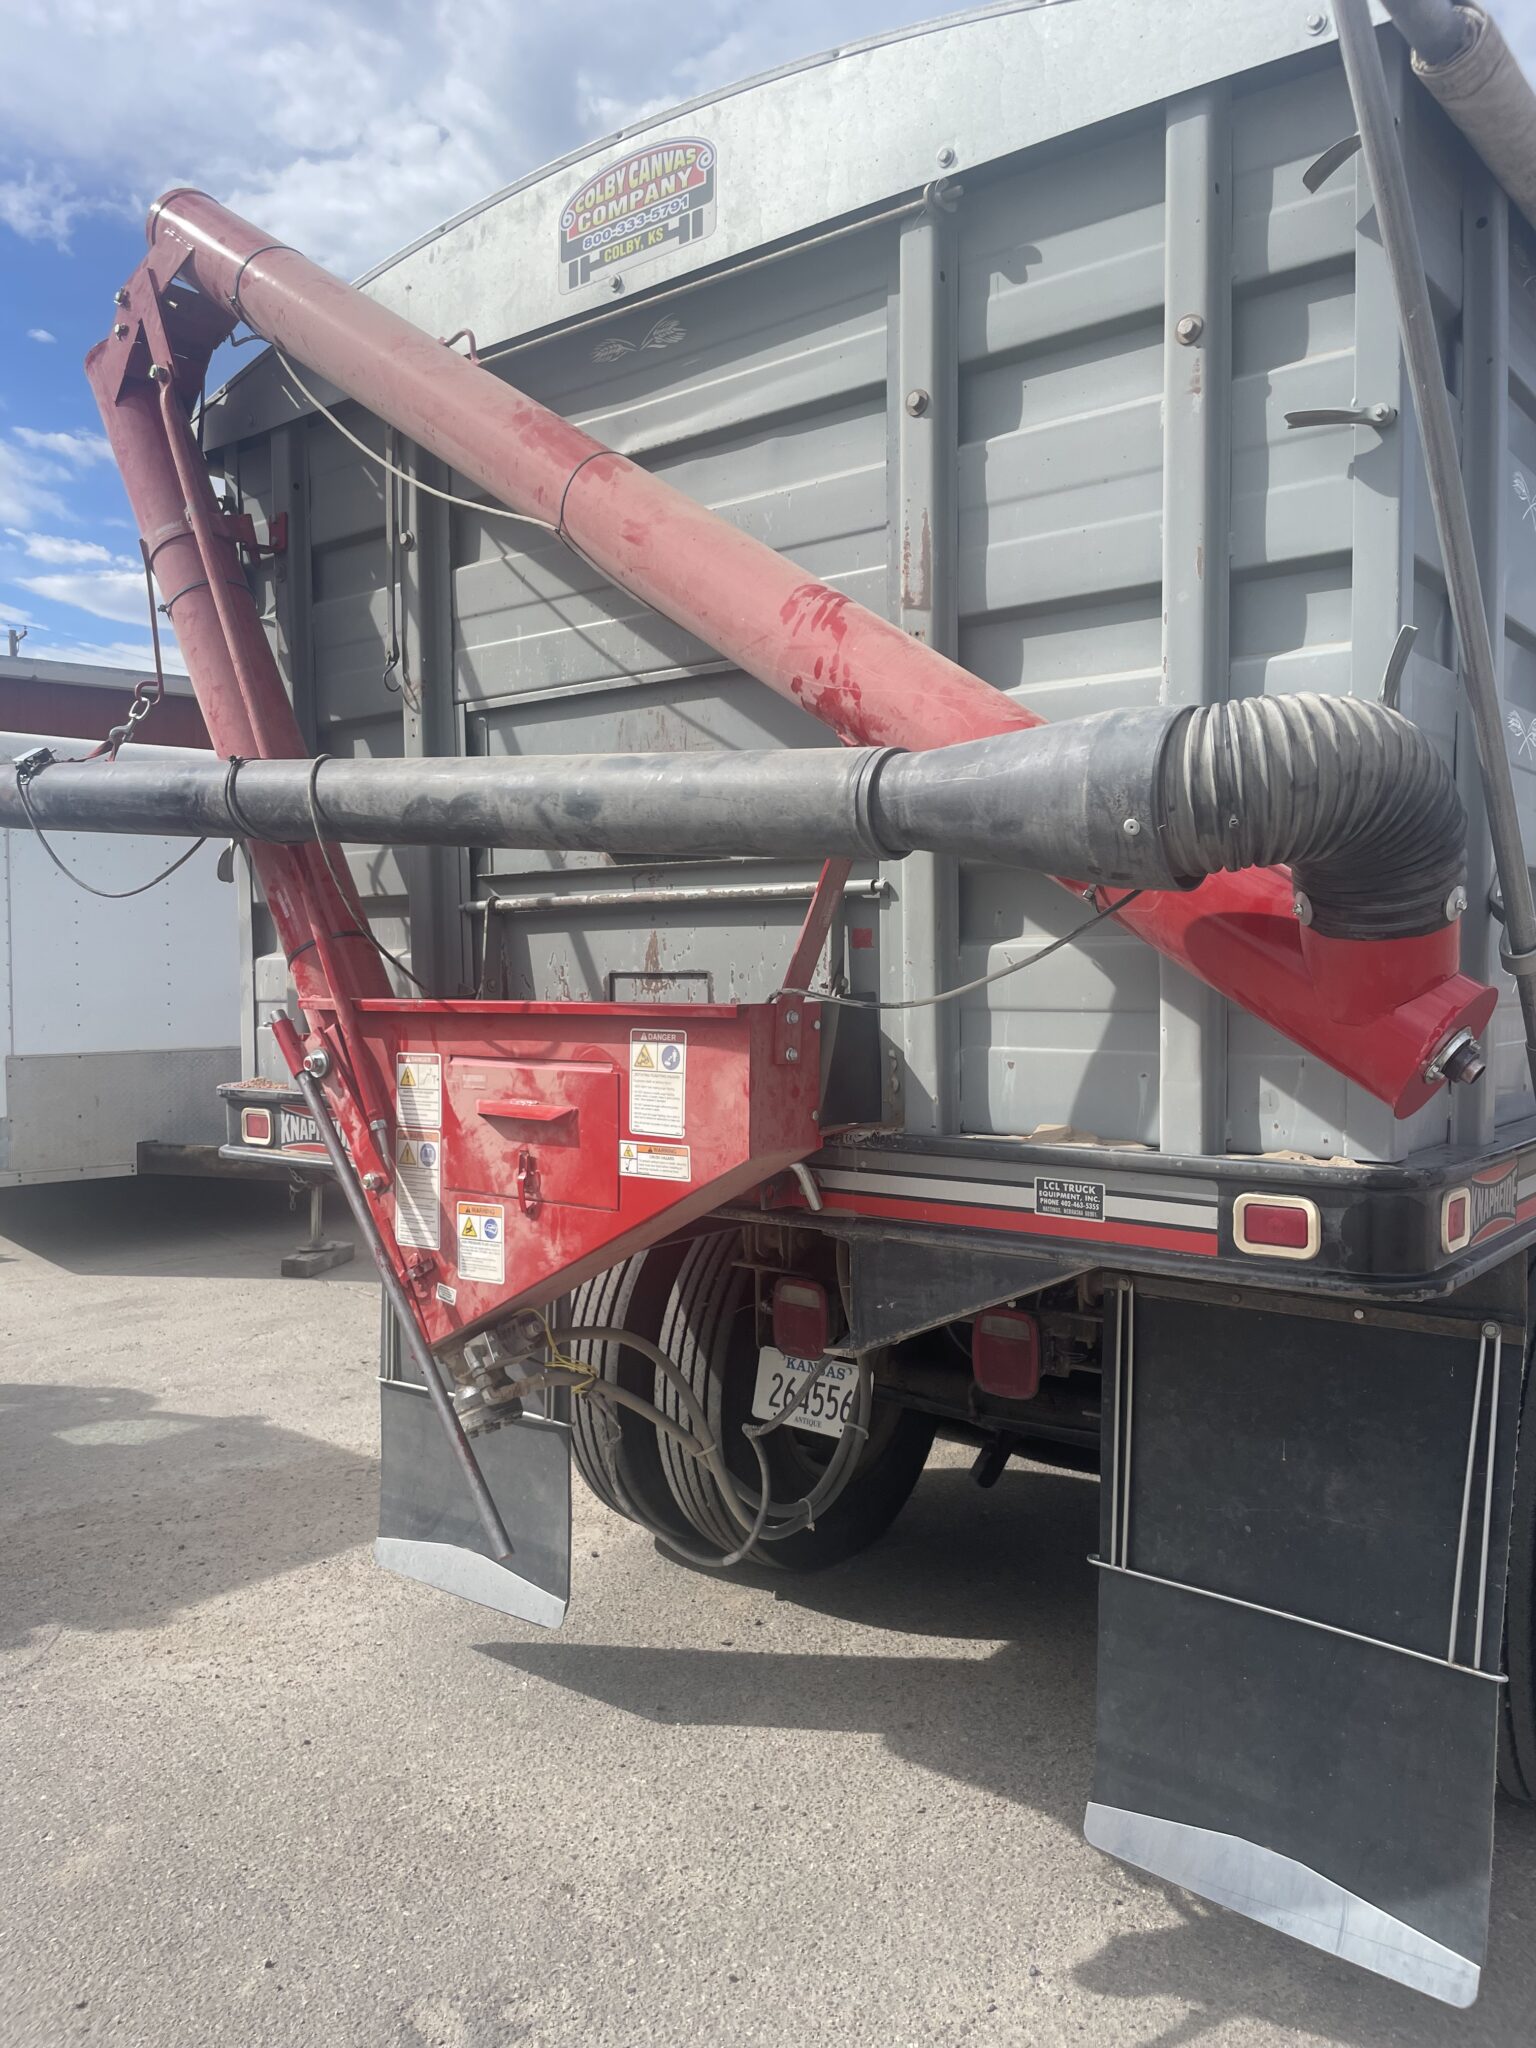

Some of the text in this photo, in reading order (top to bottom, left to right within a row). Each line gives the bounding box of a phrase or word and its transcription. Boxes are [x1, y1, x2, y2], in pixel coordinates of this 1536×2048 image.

[575, 147, 697, 214] COLBY CANVAS
[577, 167, 693, 233] COMPANY
[582, 194, 690, 251] 800-333-5791
[603, 227, 664, 263] COLBY, KS
[647, 1033, 677, 1041] DANGER
[1039, 1190, 1101, 1203] EQUIPMENT, INC.
[1043, 1181, 1096, 1195] LCL TRUCK
[1040, 1197, 1100, 1211] PHONE 402-463-5355
[1471, 1167, 1518, 1237] KNAPHEIDE
[794, 1415, 823, 1429] ANTIQUE
